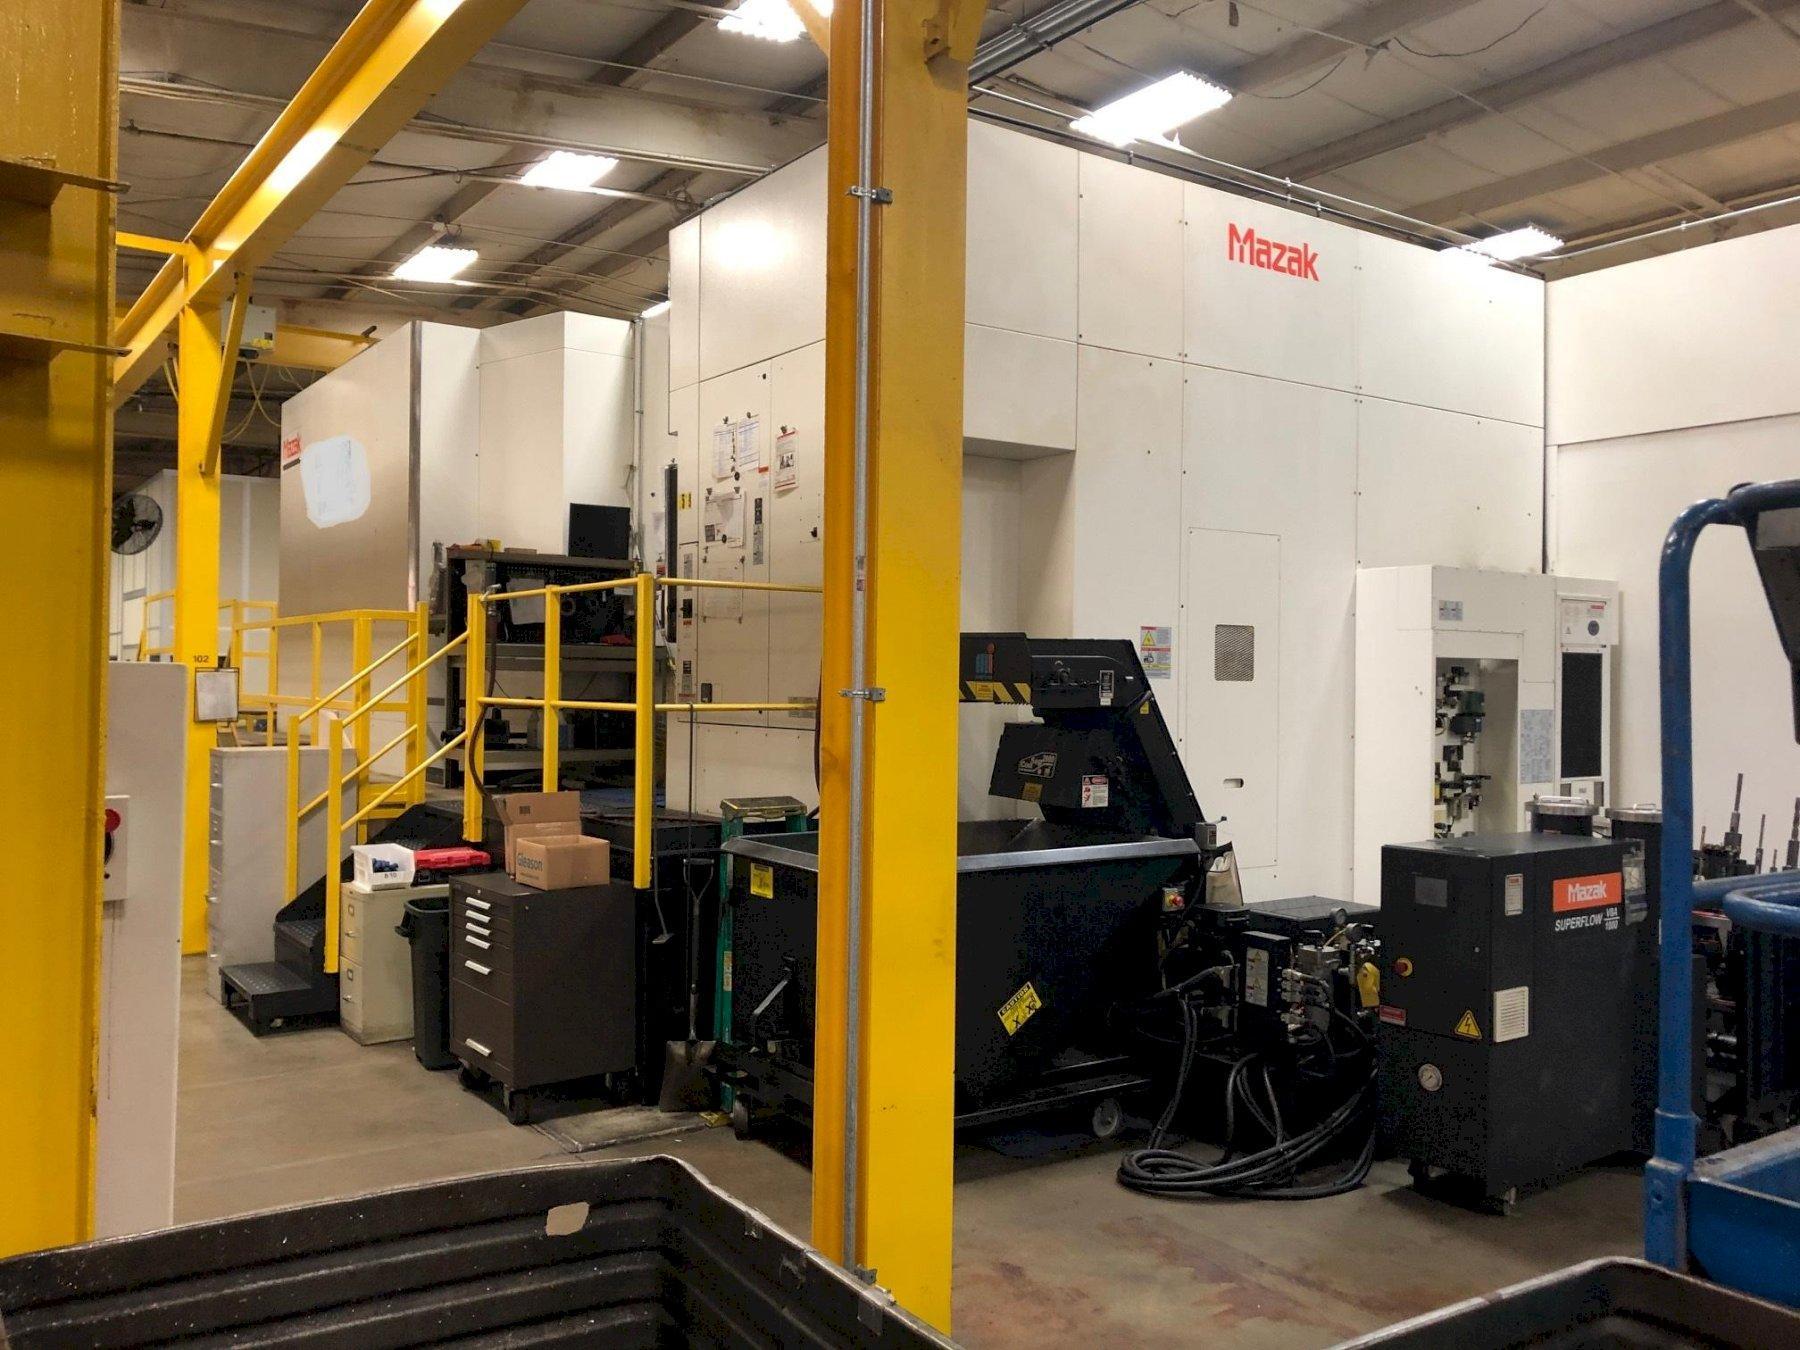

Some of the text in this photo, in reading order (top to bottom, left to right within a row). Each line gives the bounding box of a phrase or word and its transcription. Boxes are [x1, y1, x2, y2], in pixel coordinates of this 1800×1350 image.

[1228, 222, 1320, 282] Mazak
[193, 655, 209, 663] 102
[517, 853, 543, 872] Gleason
[1568, 880, 1607, 903] Mazak
[1554, 912, 1604, 932] SUPERFLOW
